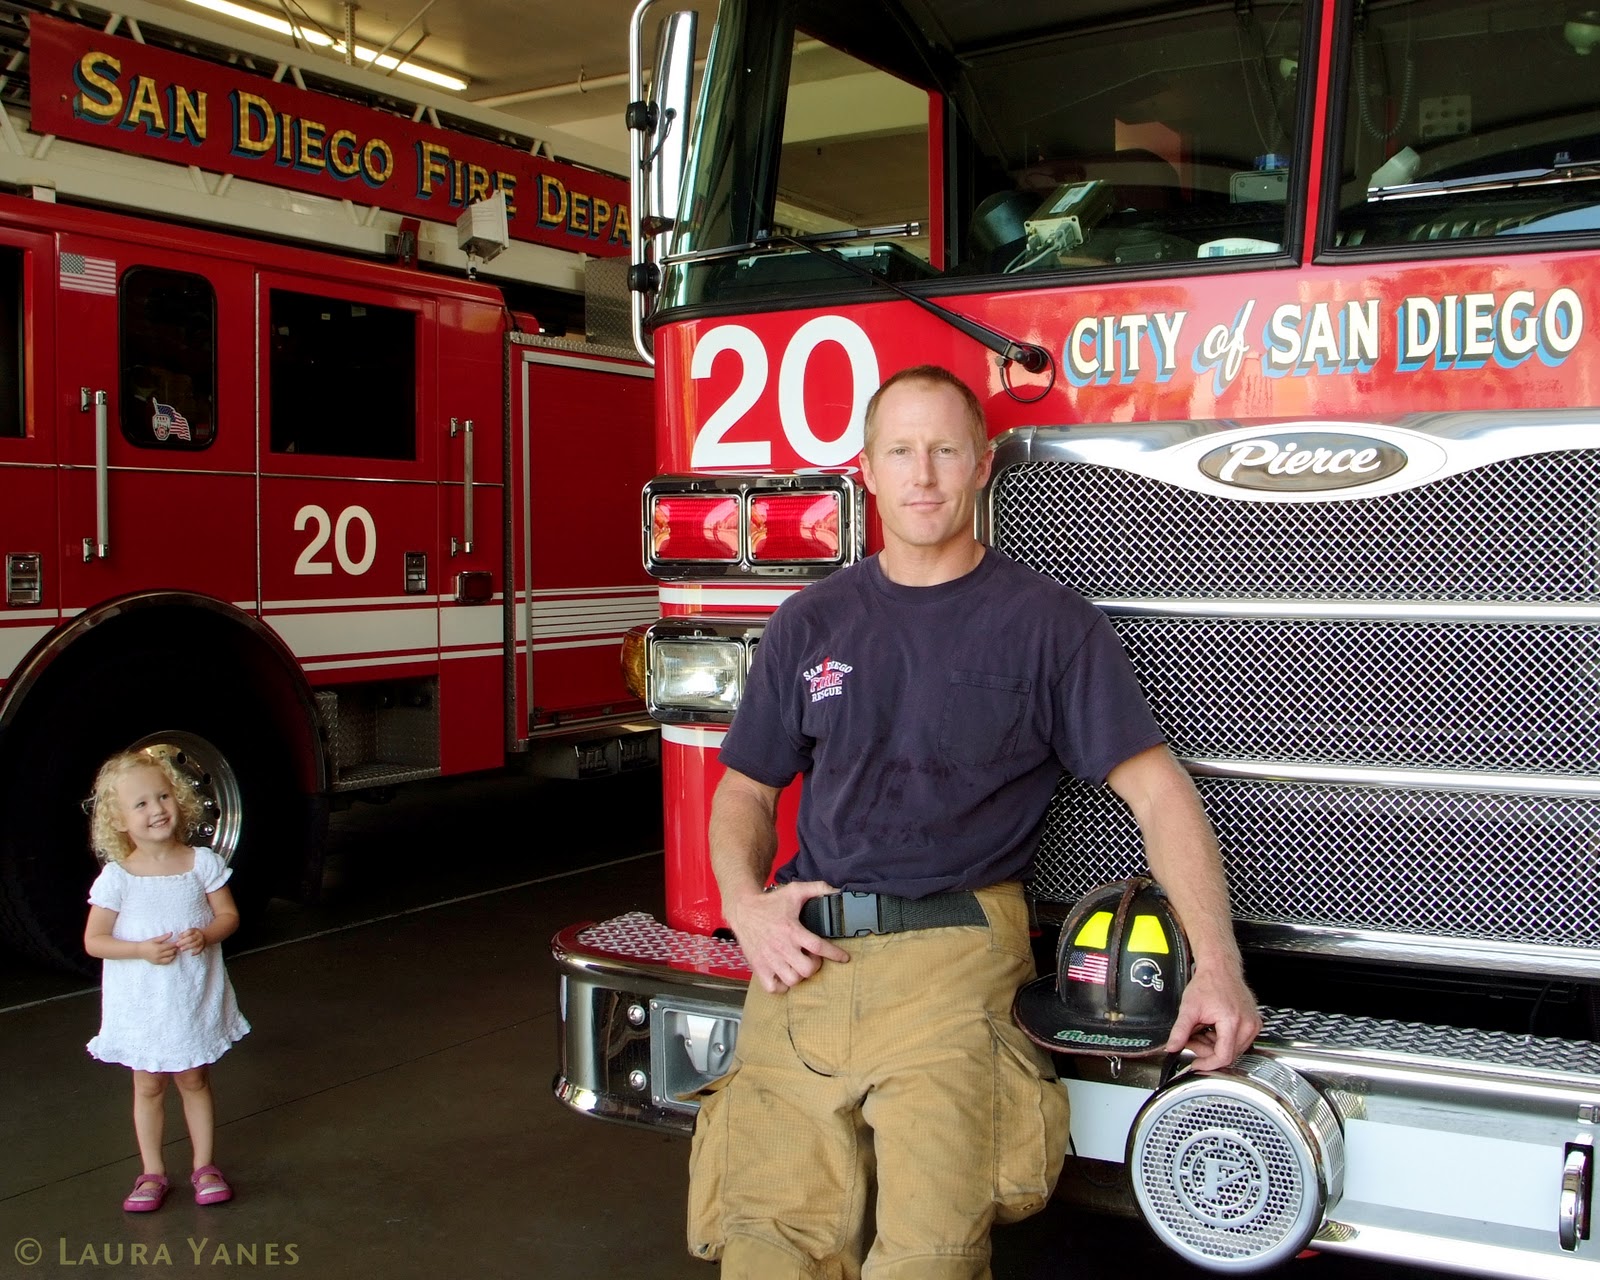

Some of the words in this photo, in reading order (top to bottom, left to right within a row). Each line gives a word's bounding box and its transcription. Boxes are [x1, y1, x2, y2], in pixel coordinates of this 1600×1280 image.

[75, 51, 208, 144] SAN
[231, 89, 394, 186] DIEGO
[416, 140, 517, 219] FIRE
[1066, 311, 1188, 384] CITY
[1196, 299, 1256, 392] of
[1265, 299, 1380, 376] SAN
[1397, 288, 1585, 369] DIEGO
[690, 315, 880, 467] 20
[1219, 440, 1381, 482] Pierce
[293, 504, 377, 576] 20
[803, 663, 824, 681] SAN
[826, 660, 853, 674] DIEGO
[810, 671, 844, 693] FIRE
[811, 686, 843, 703] RESCUE
